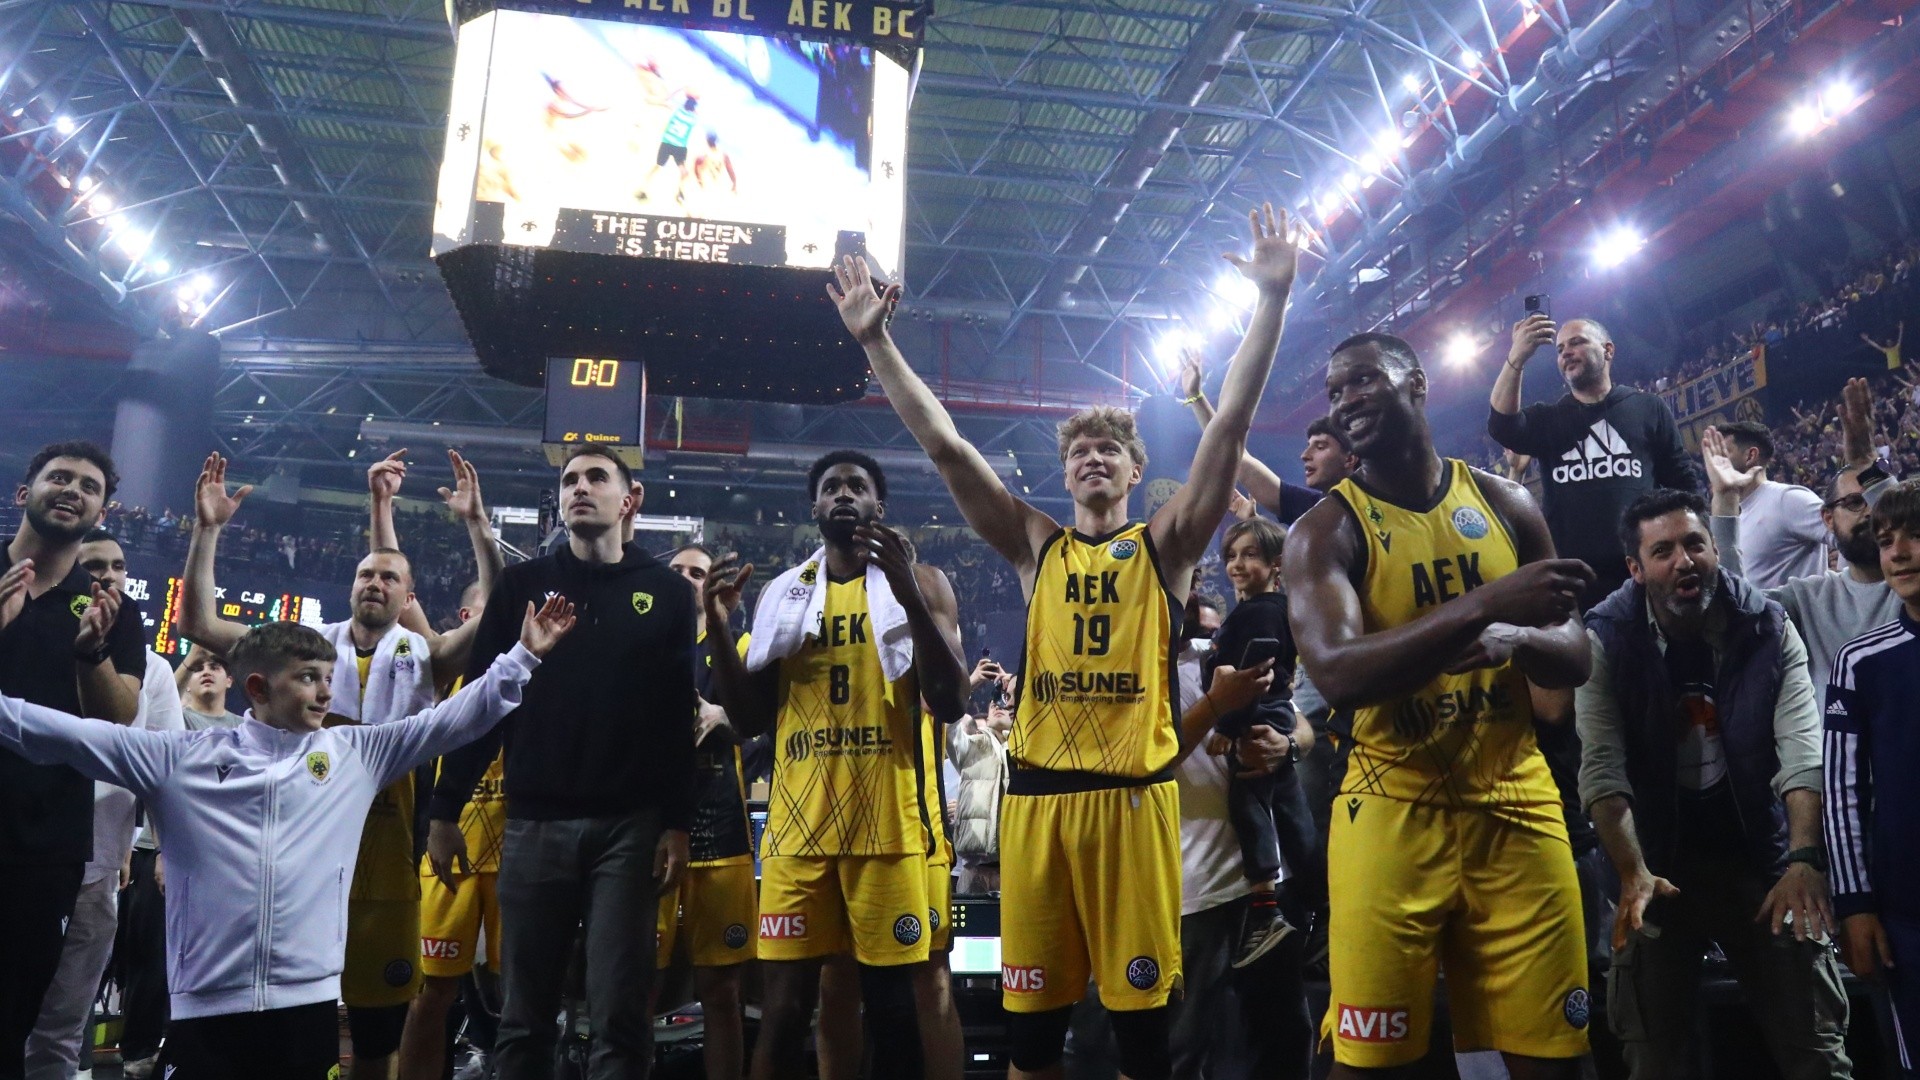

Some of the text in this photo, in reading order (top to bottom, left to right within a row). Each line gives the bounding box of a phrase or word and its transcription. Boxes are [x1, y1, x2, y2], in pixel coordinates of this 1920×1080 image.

[712, 0, 755, 21] BC
[787, 1, 914, 39] AEK BC
[592, 214, 753, 245] THE QUEEN
[616, 236, 730, 263] IS HERE
[1552, 454, 1642, 484] adidas
[1064, 571, 1120, 605] AEK
[1411, 551, 1486, 608] AEK
[812, 612, 868, 648] AEK
[1073, 612, 1111, 656] 19
[829, 664, 850, 705] 8
[1060, 671, 1146, 694] SUNEL
[1436, 682, 1513, 719] SUNE
[813, 726, 893, 748] SUNEL
[759, 915, 806, 937] AVIS
[1002, 965, 1044, 990] AVIS
[1338, 1008, 1408, 1039] AVIS
